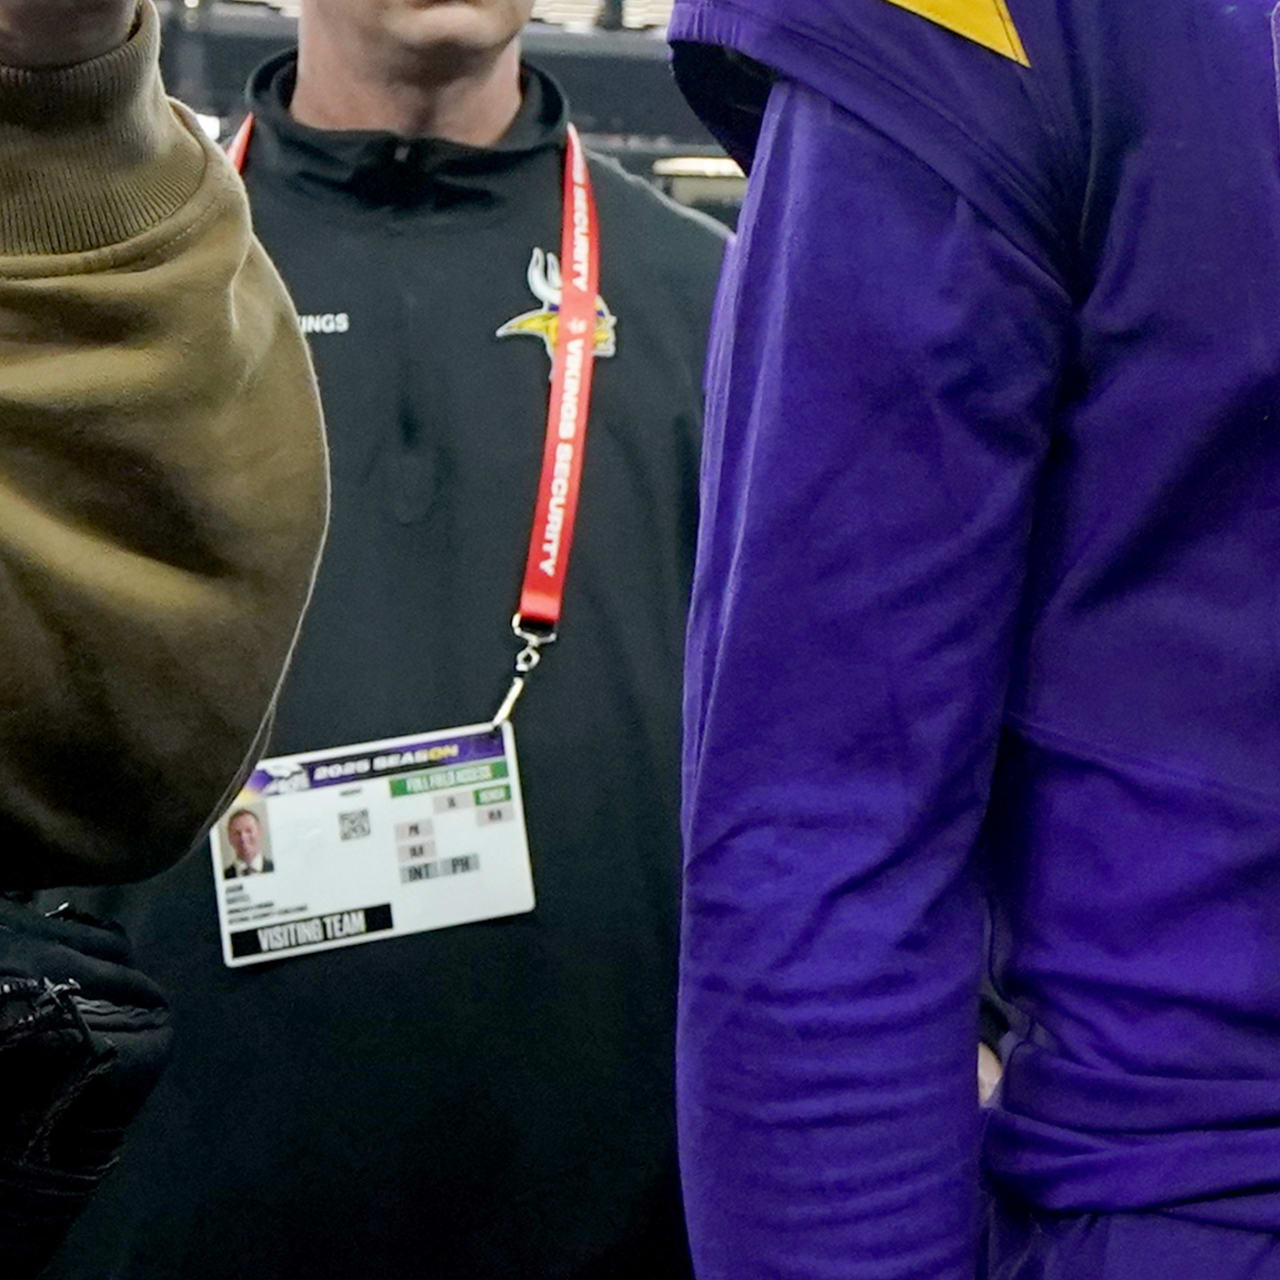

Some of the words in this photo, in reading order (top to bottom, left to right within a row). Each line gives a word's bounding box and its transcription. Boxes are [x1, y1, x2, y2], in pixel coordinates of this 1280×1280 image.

[297, 312, 350, 334] INGS
[558, 339, 584, 440] VIKINGS
[538, 442, 574, 577] SECURITY
[313, 758, 371, 781] 2025
[372, 743, 460, 772] SEASON
[408, 863, 431, 882] INT
[257, 917, 324, 952] VISITING
[323, 909, 367, 940] TEAM
